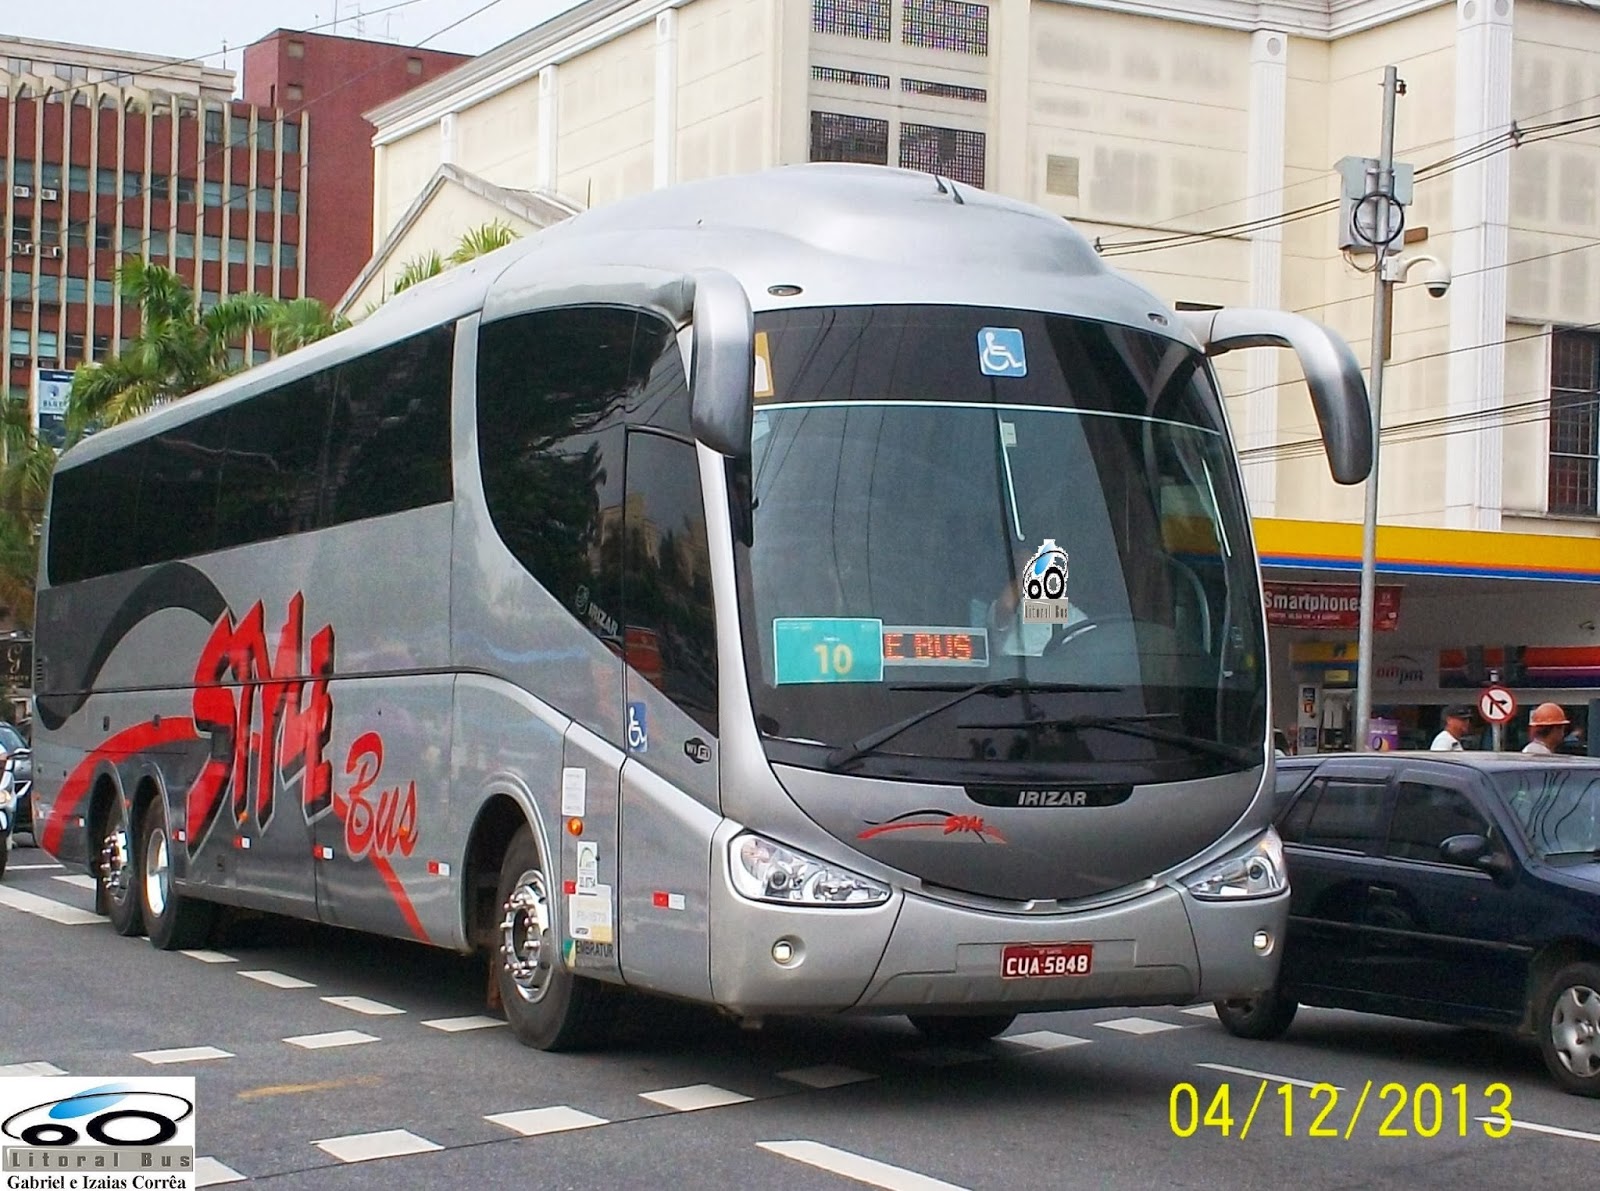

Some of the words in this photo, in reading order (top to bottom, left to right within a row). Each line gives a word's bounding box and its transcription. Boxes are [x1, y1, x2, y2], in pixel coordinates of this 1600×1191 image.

[1263, 591, 1360, 612] Smartphone
[588, 602, 618, 636] IRIZAR
[813, 644, 853, 674] 10
[913, 632, 972, 660] BUS
[345, 731, 418, 861] Bus
[1018, 791, 1087, 806] IRIZAR
